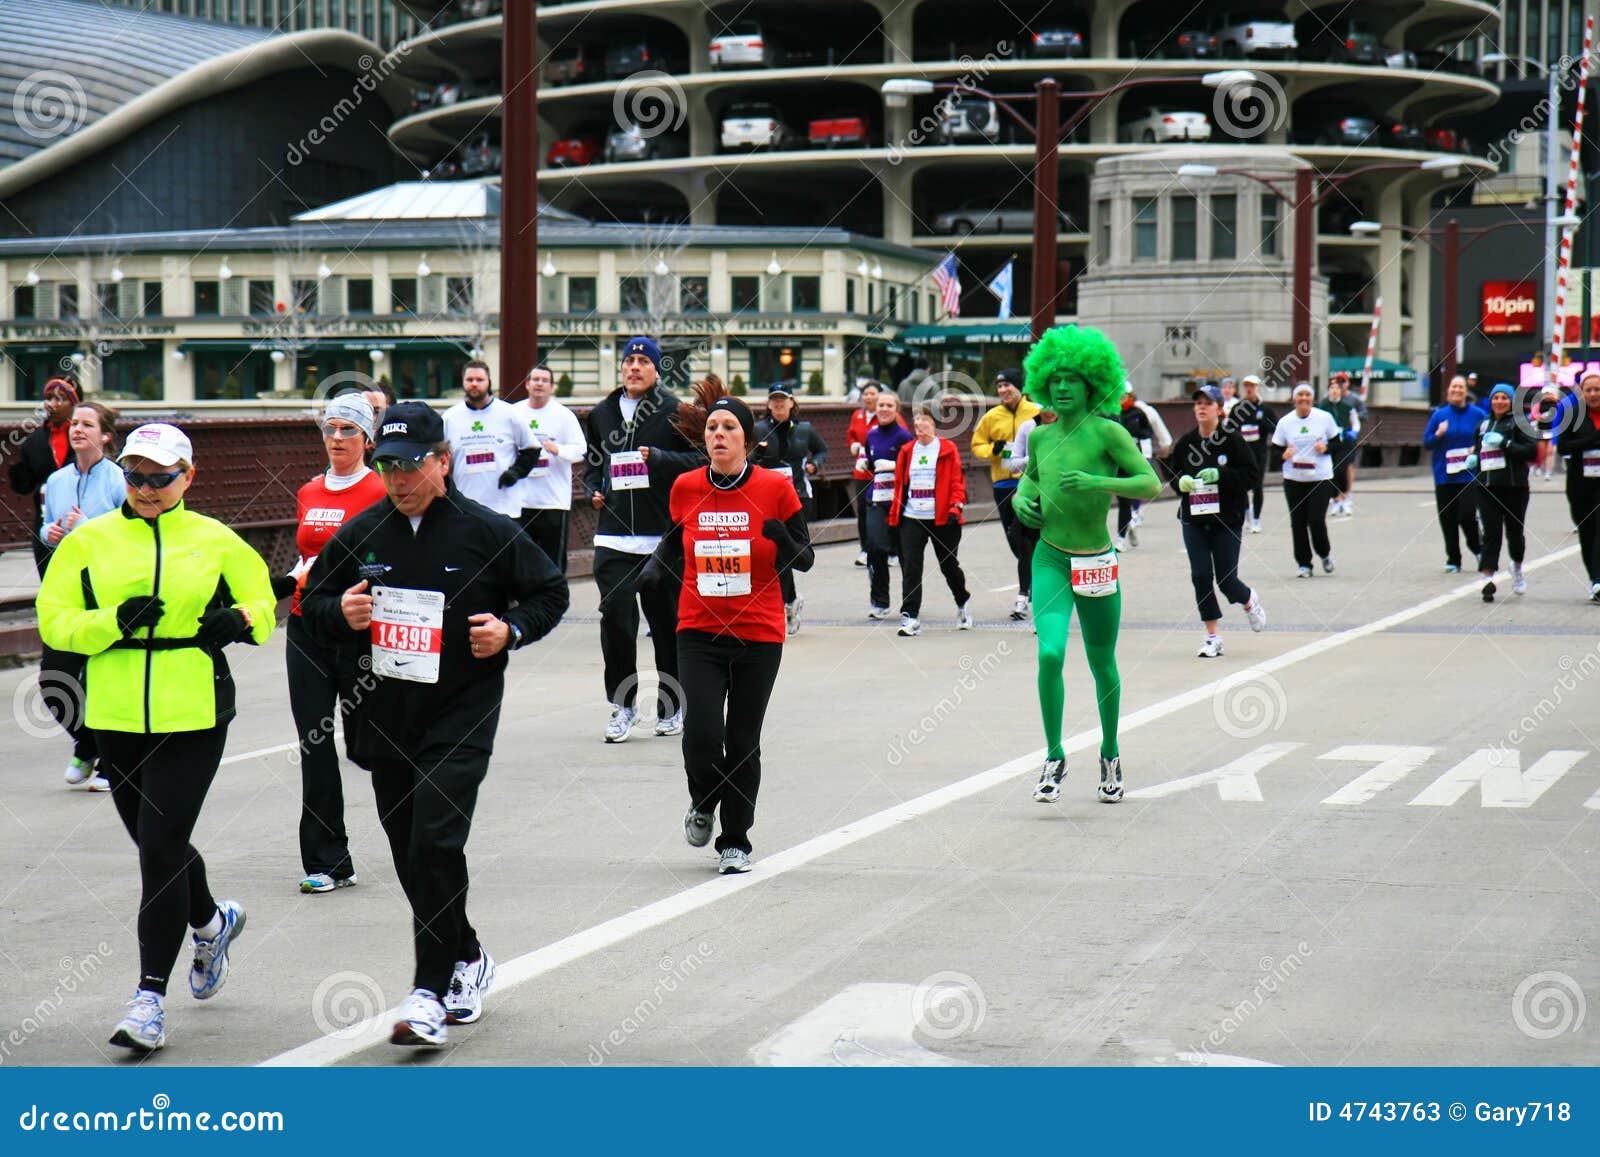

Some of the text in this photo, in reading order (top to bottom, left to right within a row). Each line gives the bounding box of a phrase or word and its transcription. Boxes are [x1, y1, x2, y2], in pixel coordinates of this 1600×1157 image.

[1484, 296, 1535, 317] 10pin
[551, 319, 599, 332] SMITH
[382, 422, 408, 436] NIKE
[705, 557, 741, 574] A 345
[1079, 567, 1113, 585] 15399
[379, 623, 432, 652] 14399
[1125, 743, 1600, 809] NLY
